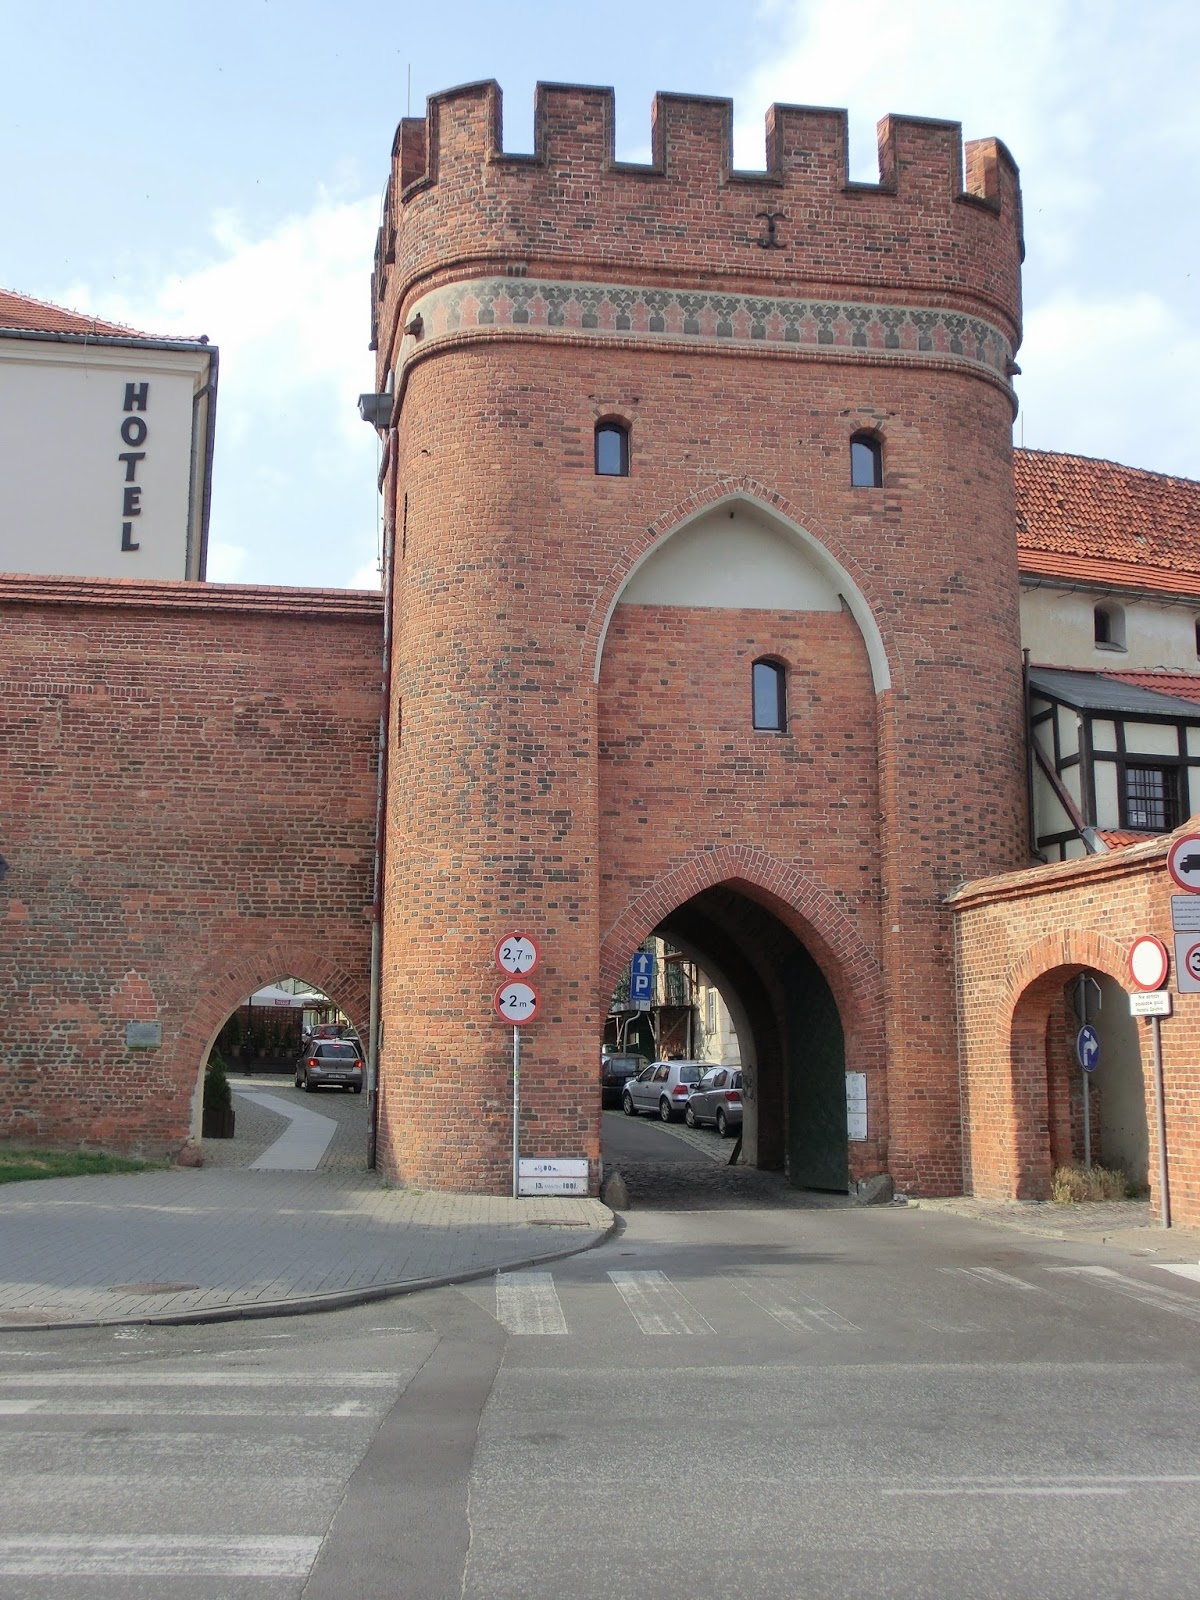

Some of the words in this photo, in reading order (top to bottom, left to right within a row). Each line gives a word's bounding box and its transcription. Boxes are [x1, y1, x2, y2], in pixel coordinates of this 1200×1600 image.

[119, 382, 149, 551] HOTEL
[503, 947, 523, 963] 2,7
[635, 975, 648, 993] P
[509, 994, 517, 1007] 2
